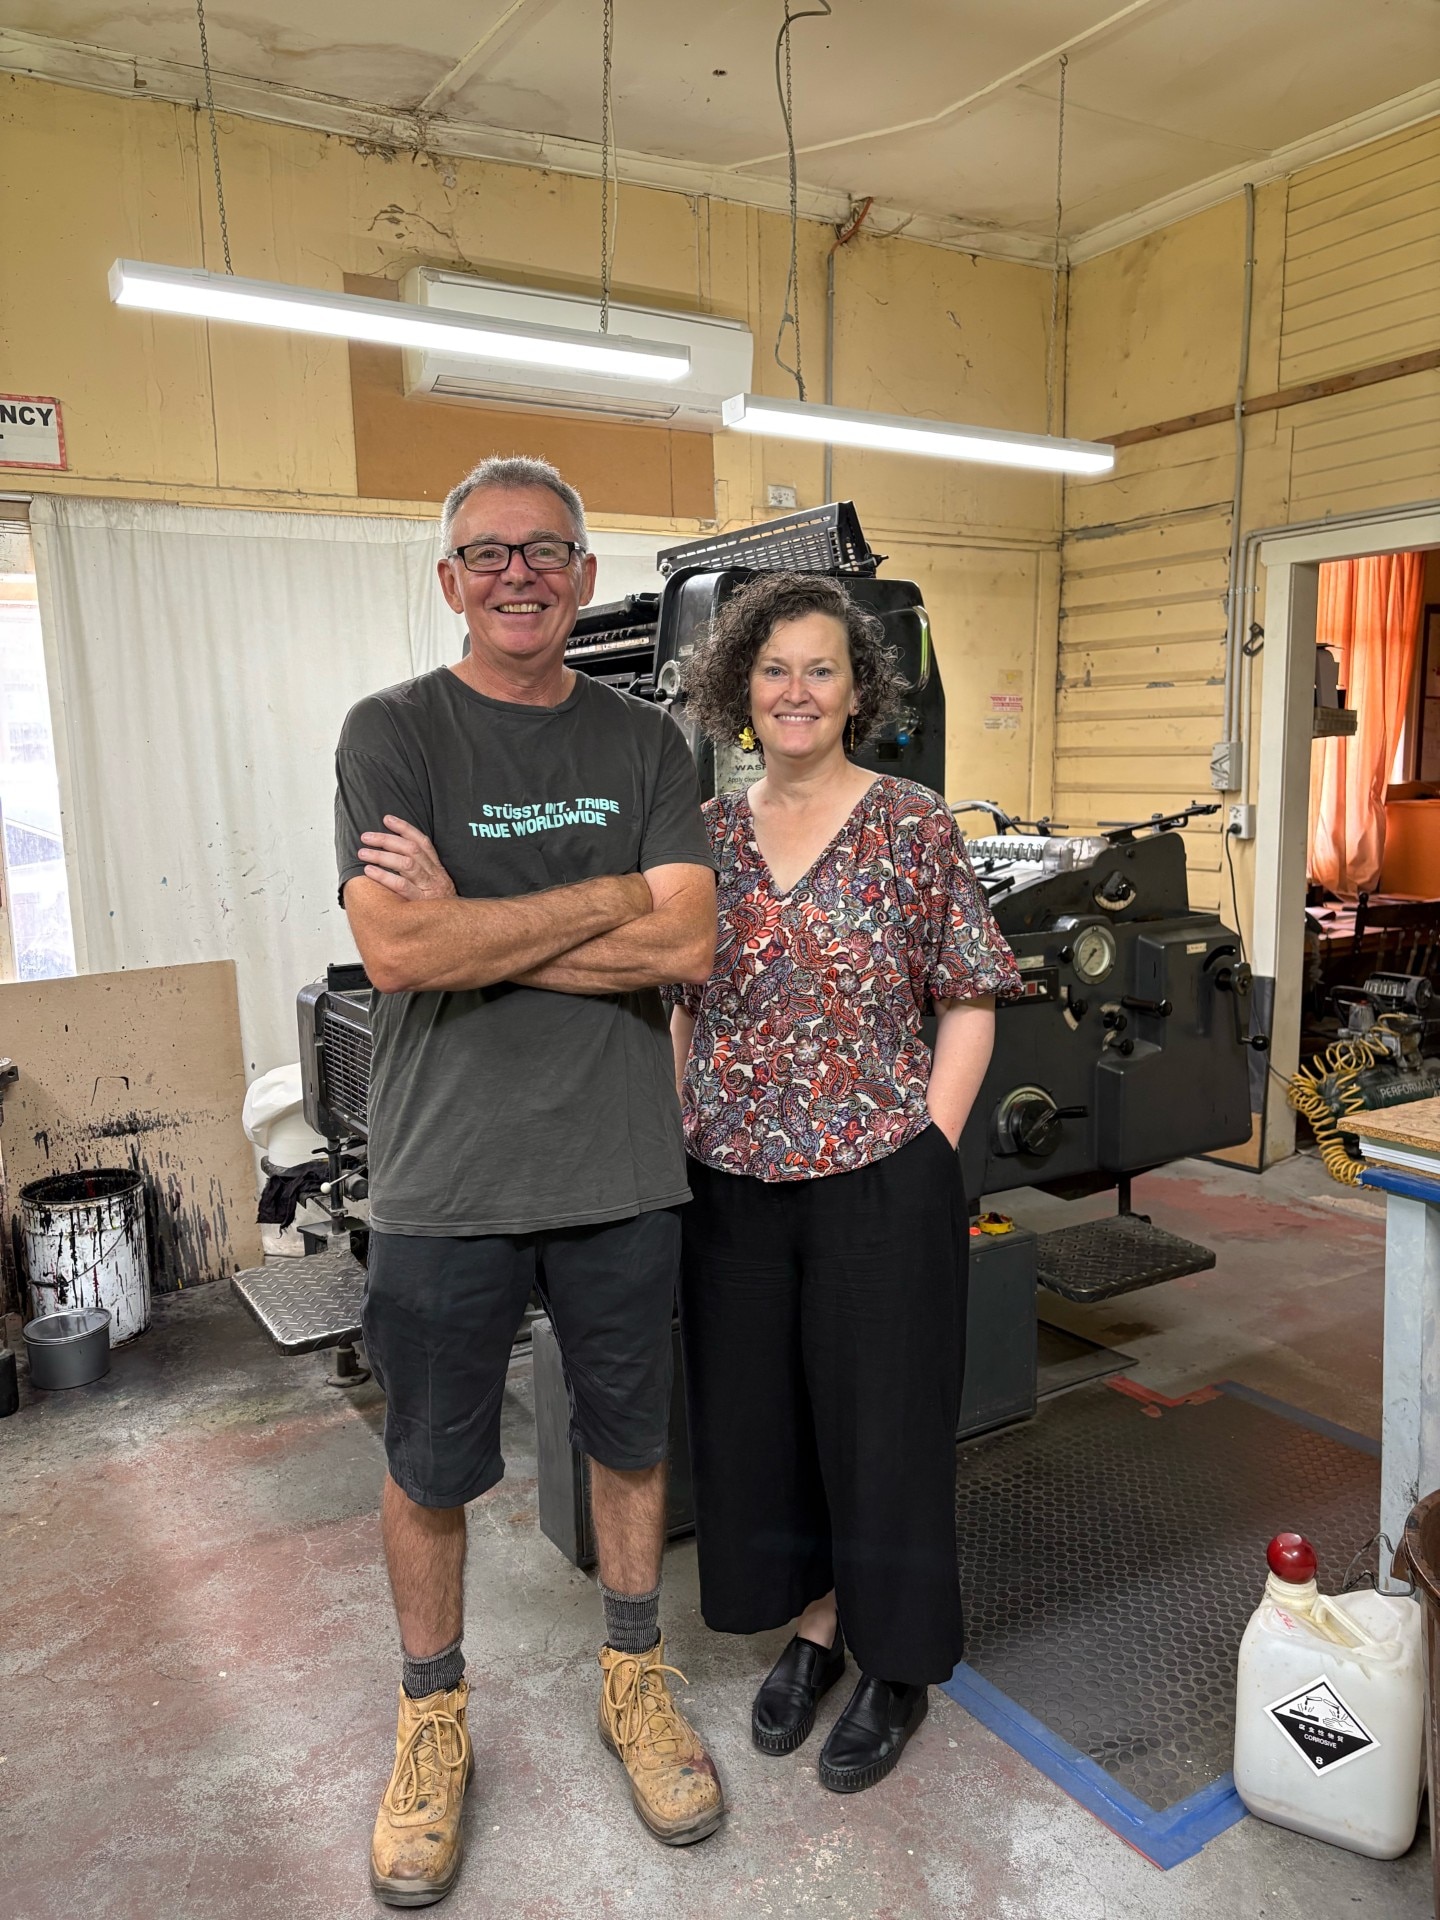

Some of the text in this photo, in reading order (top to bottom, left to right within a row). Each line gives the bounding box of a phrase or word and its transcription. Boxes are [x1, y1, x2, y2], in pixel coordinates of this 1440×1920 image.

[482, 803, 542, 820] STÜSSY
[575, 798, 621, 814] TRIBE
[468, 810, 607, 838] TRUE WORLDWIDE
[1303, 1733, 1337, 1749] CORROSIVE
[1315, 1756, 1324, 1765] 8
